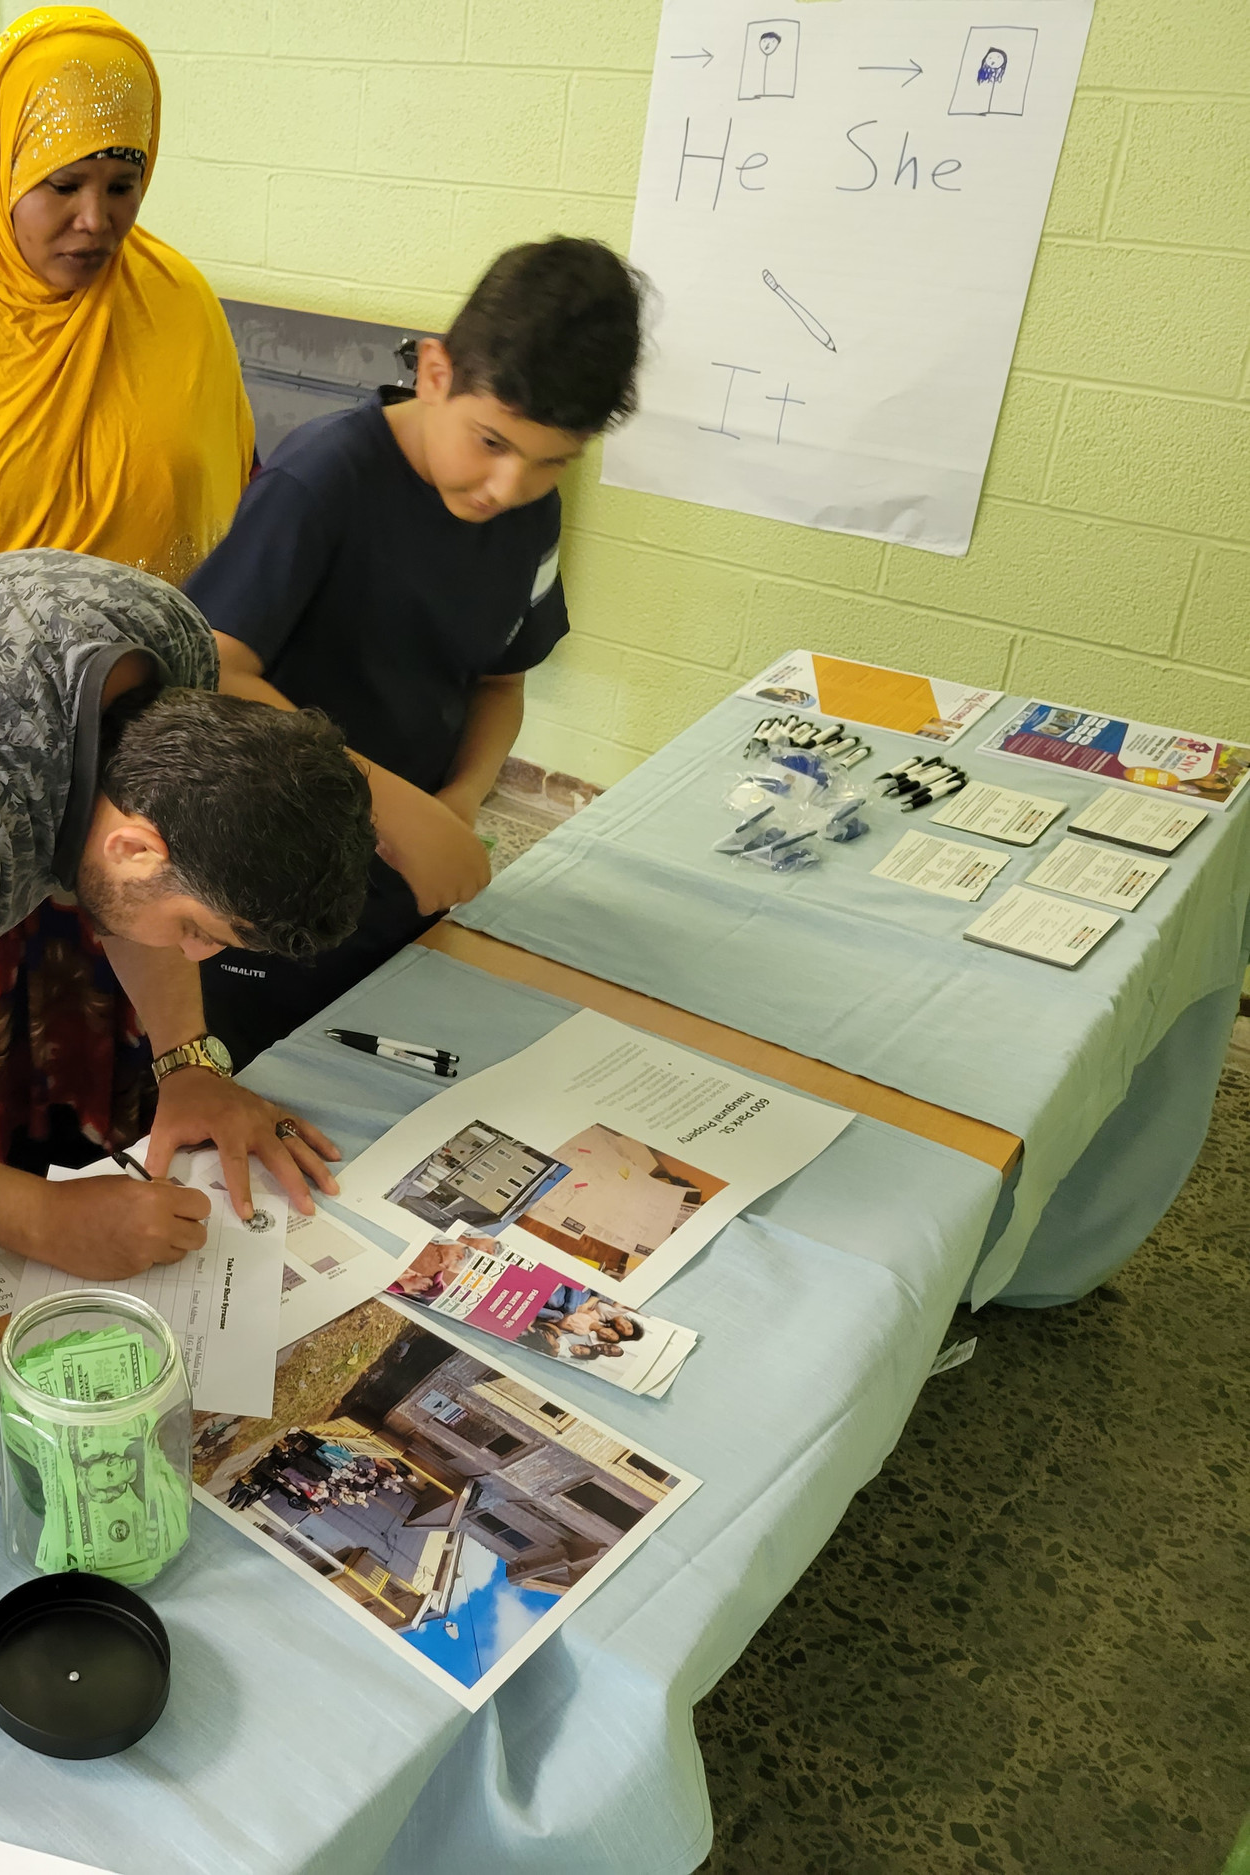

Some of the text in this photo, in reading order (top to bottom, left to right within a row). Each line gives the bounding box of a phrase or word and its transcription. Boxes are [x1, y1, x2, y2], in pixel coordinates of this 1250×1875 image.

[675, 116, 962, 212] He She
[698, 361, 806, 445] It
[712, 1091, 755, 1123] Inaugural
[750, 1098, 770, 1113] 600
[730, 1111, 755, 1127] Park
[677, 1121, 717, 1144] Property
[224, 1272, 232, 1287] Your
[223, 1287, 231, 1302] Shot
[190, 1290, 200, 1325] Email Address
[220, 1303, 229, 1330] Syracuse
